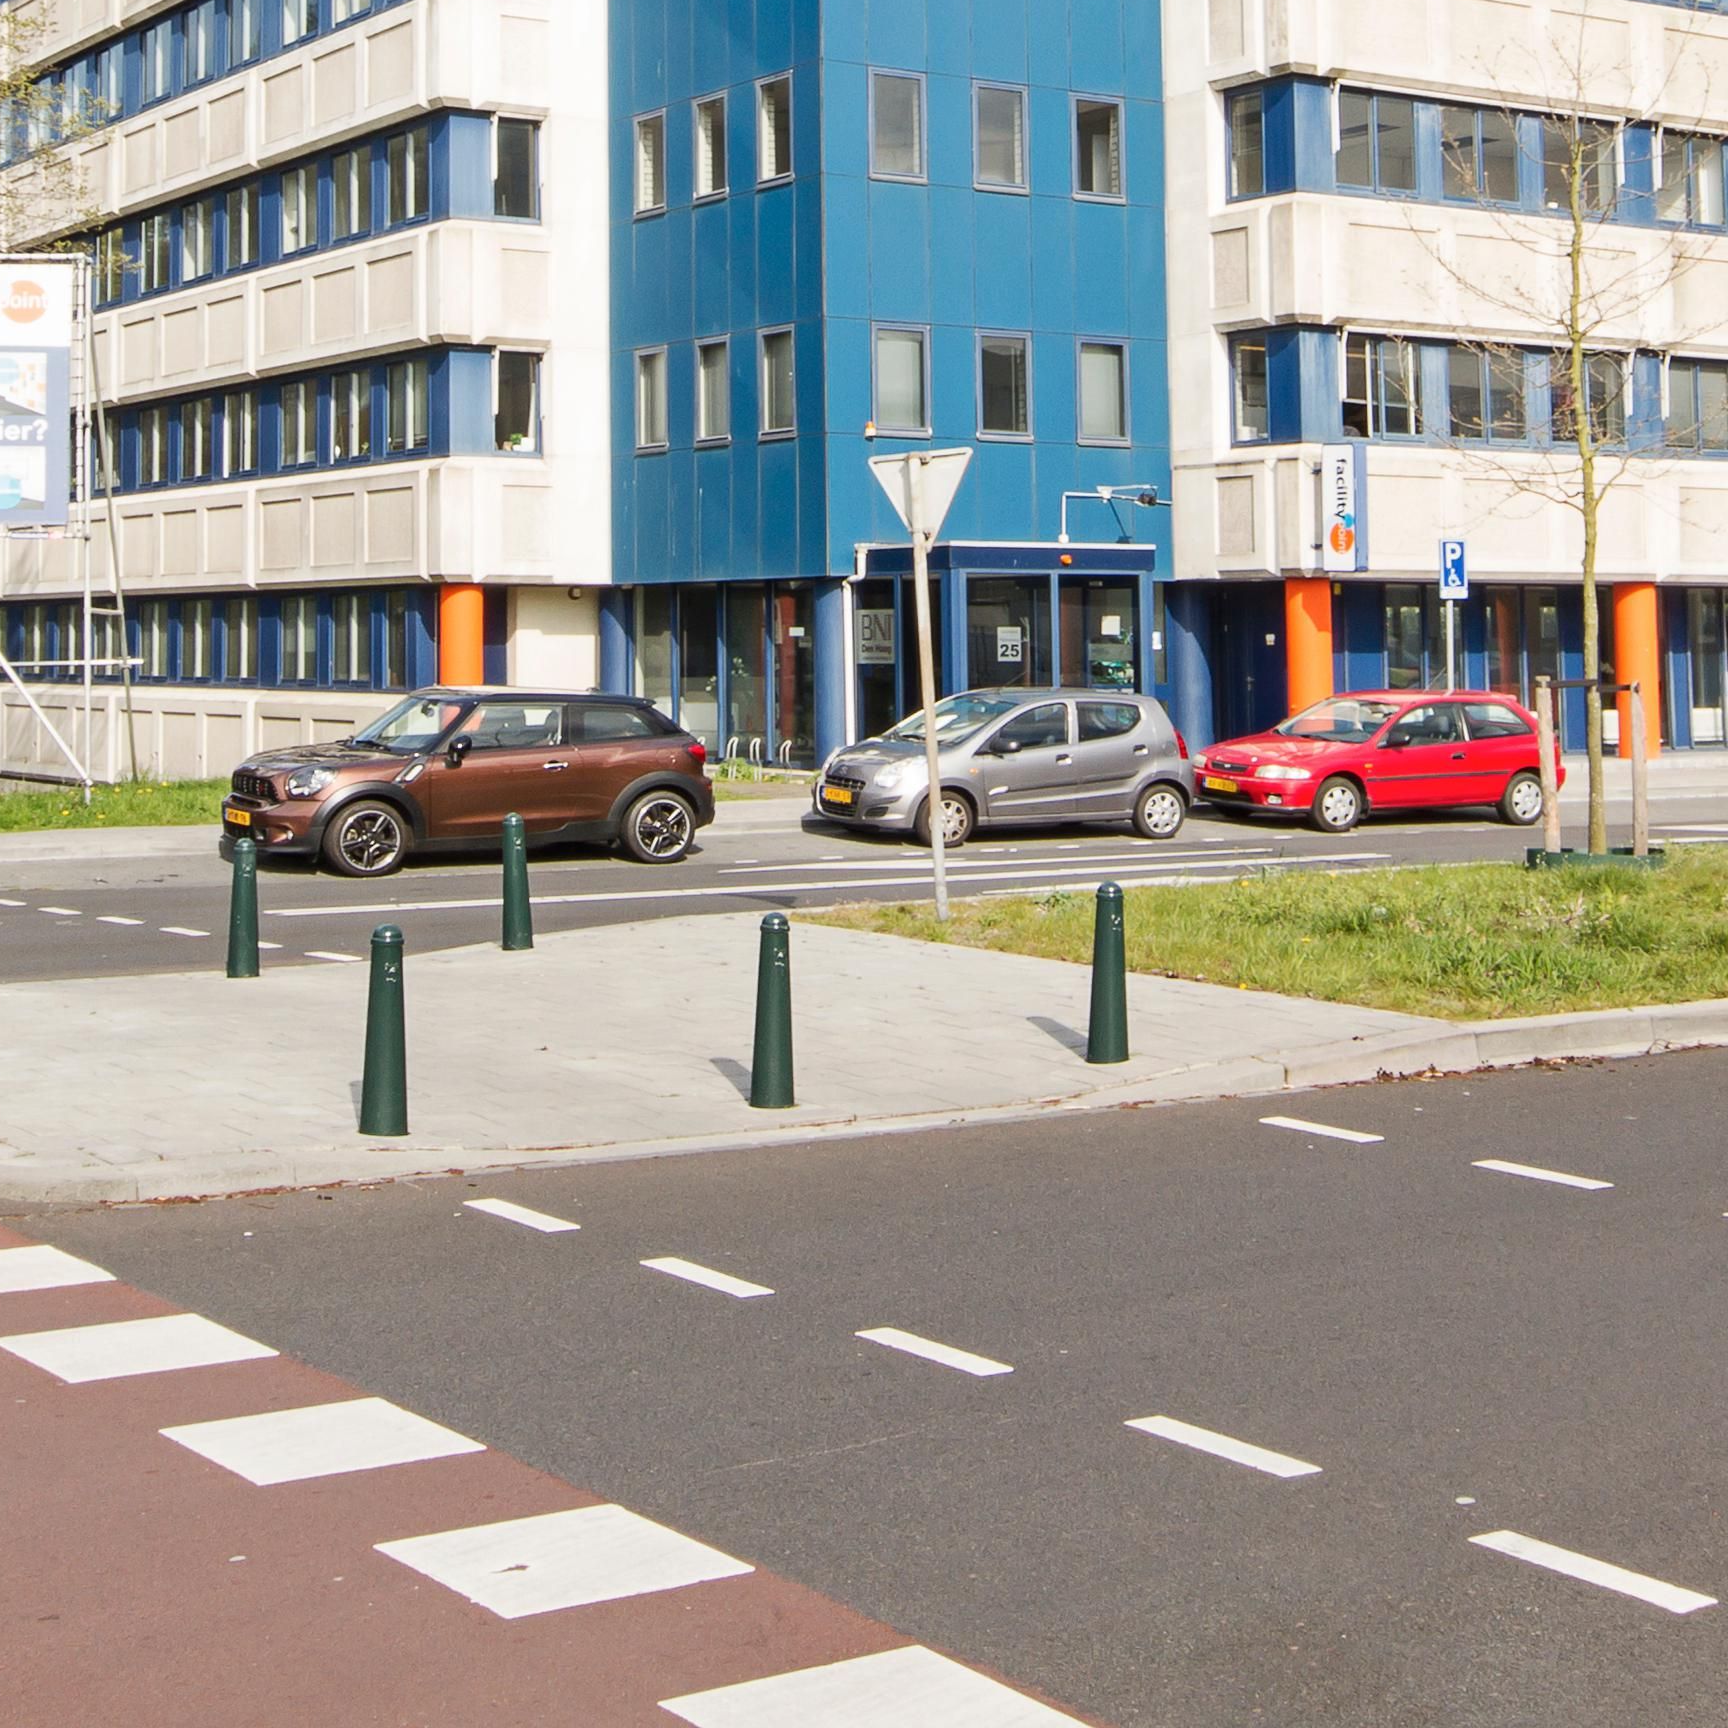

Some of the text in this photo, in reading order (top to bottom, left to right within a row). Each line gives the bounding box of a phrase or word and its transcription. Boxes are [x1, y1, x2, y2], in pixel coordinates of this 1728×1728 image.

[1334, 458, 1348, 520] facility
[1445, 542, 1462, 569] P
[1000, 643, 1019, 658] 25
